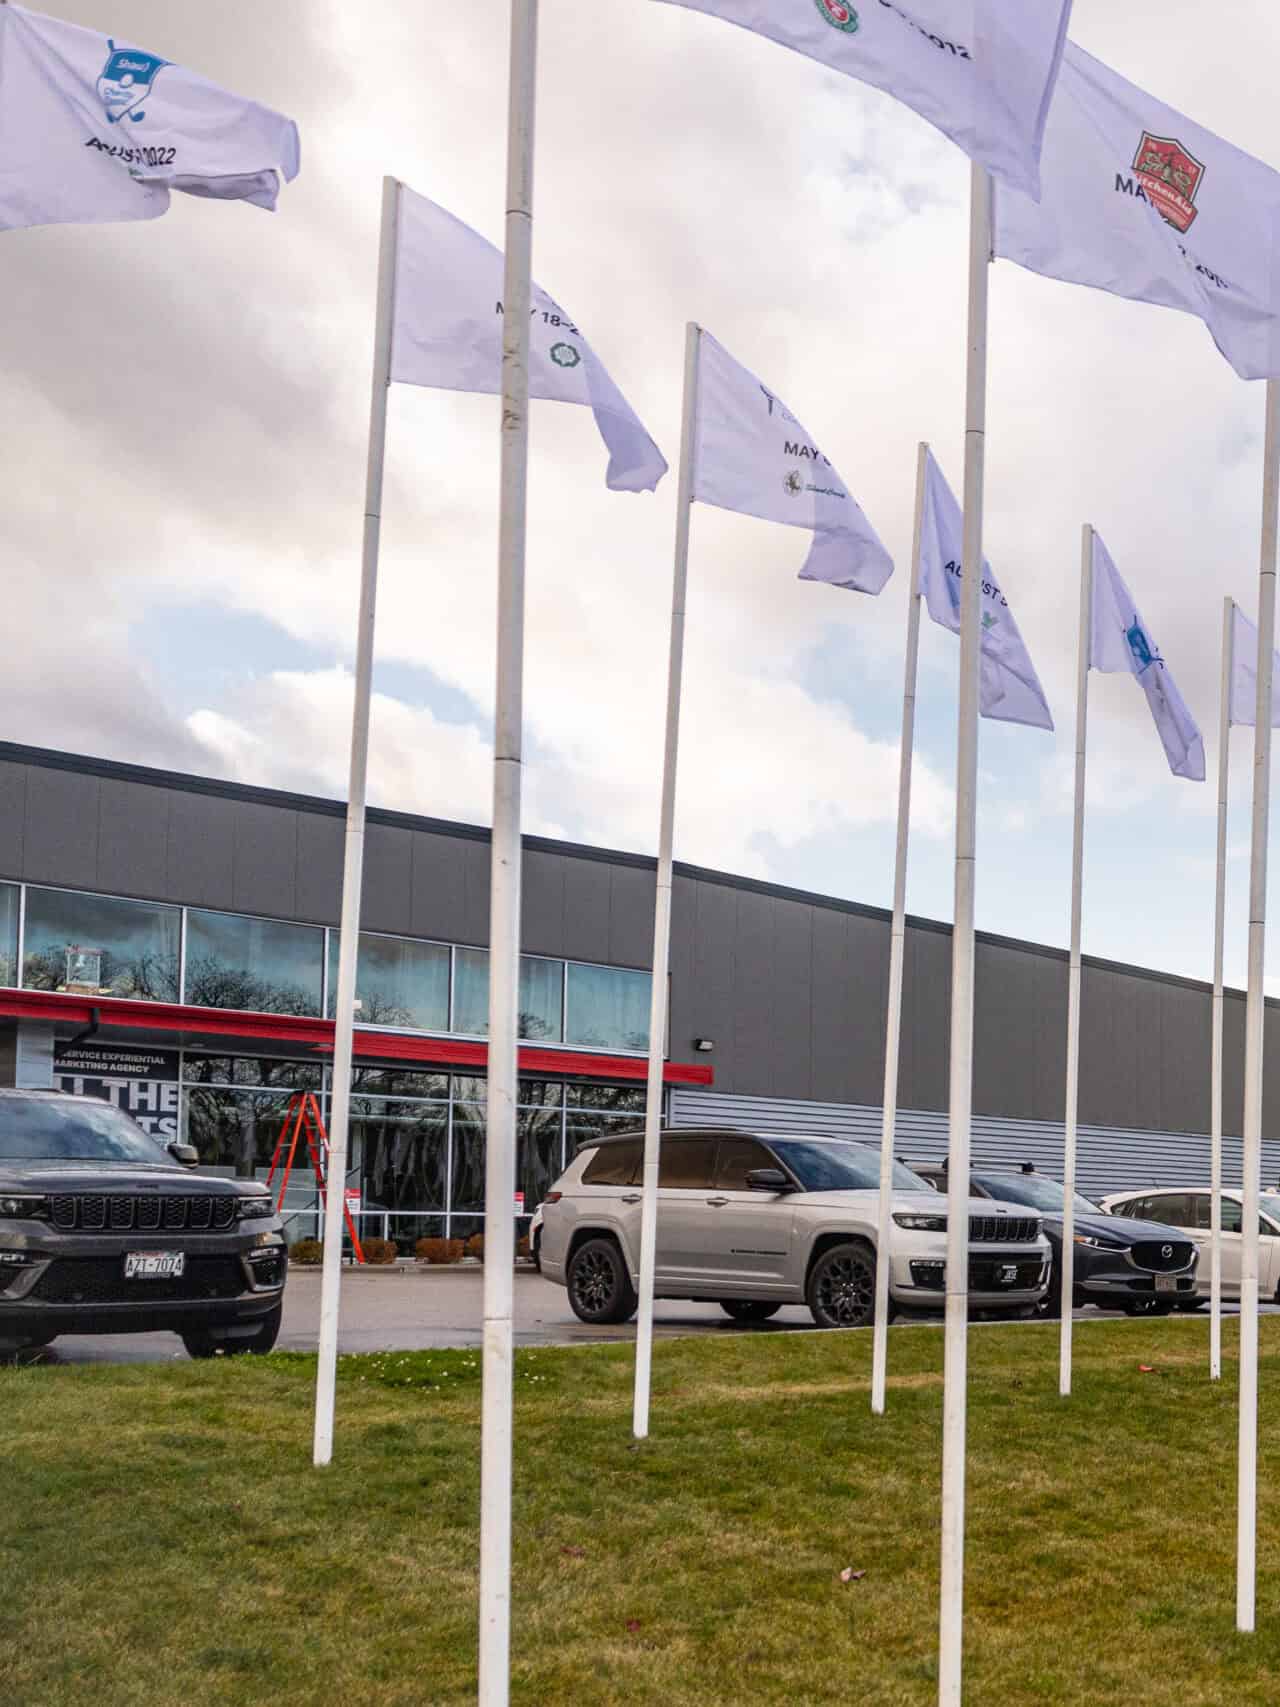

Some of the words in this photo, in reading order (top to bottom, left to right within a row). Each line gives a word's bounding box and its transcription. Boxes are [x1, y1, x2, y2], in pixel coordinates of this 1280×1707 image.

[1115, 173, 1154, 207] MA
[784, 441, 819, 460] MAY
[102, 1051, 166, 1064] EXPERIENTIAL
[109, 1062, 151, 1073] AGENCY
